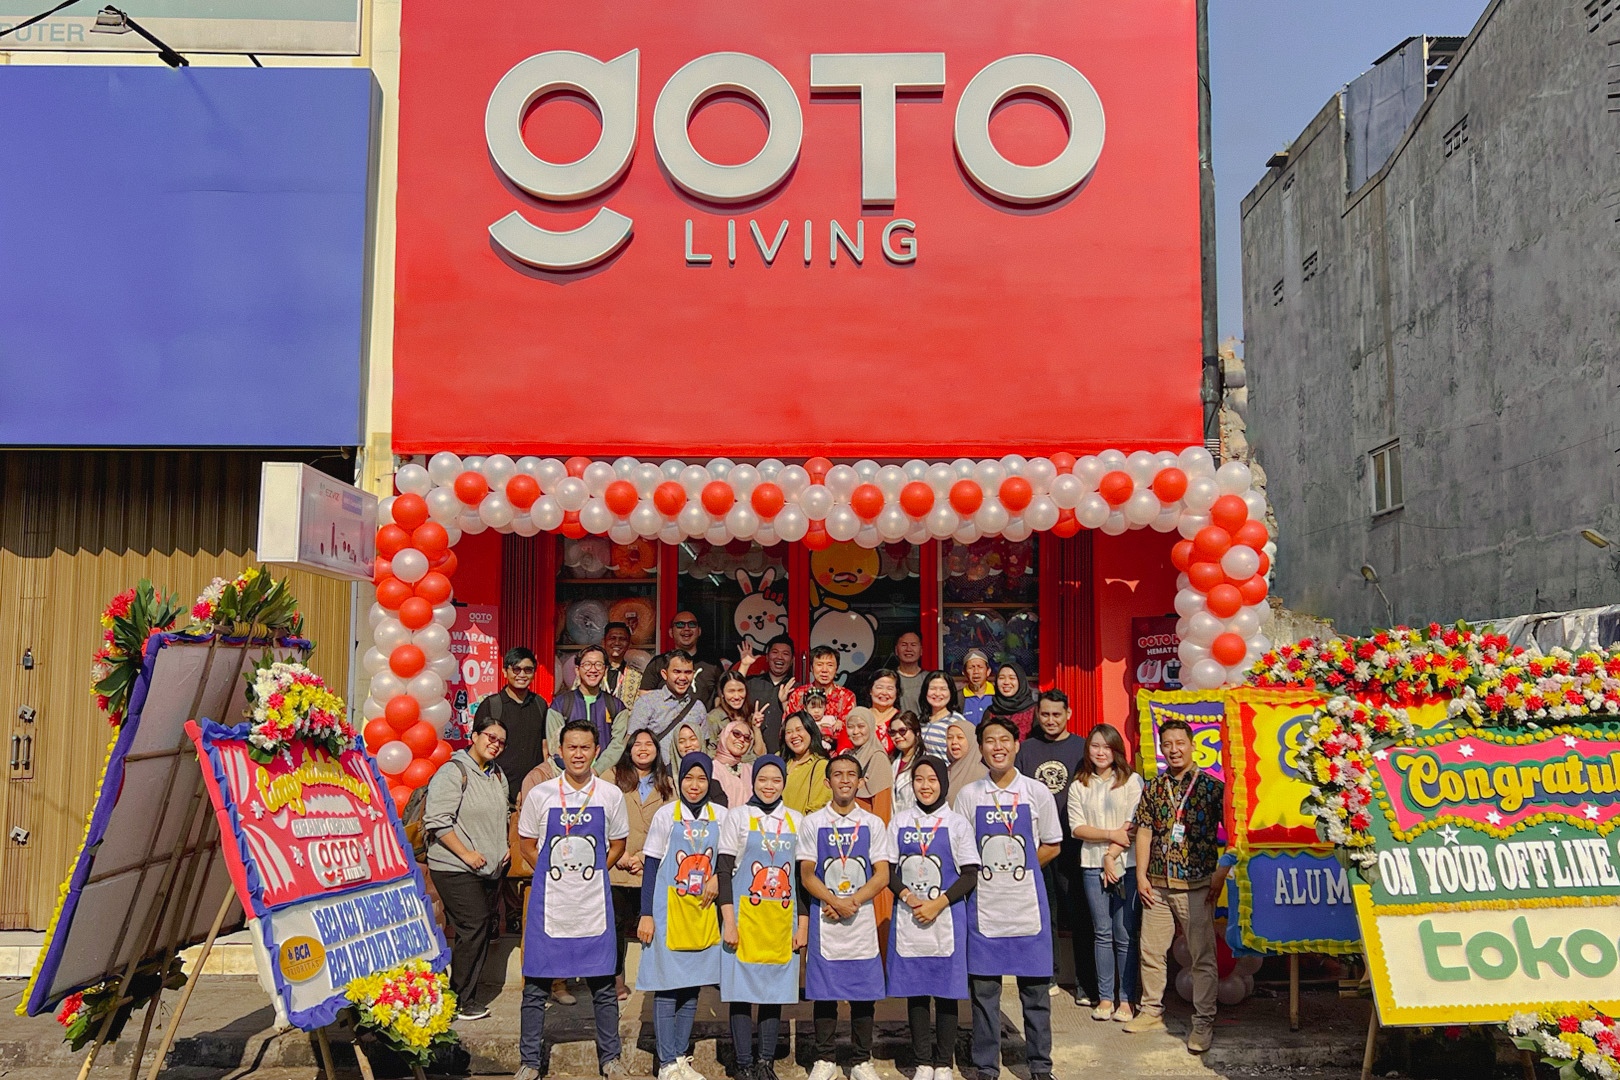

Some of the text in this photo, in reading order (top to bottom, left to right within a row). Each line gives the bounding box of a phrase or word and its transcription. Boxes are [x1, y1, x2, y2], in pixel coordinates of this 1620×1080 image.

[685, 218, 918, 266] LIVING
[481, 675, 495, 683] OFF
[1378, 838, 1620, 896] ON YOUR OFFLINE
[294, 943, 311, 961] BCA
[326, 946, 353, 989] BCA
